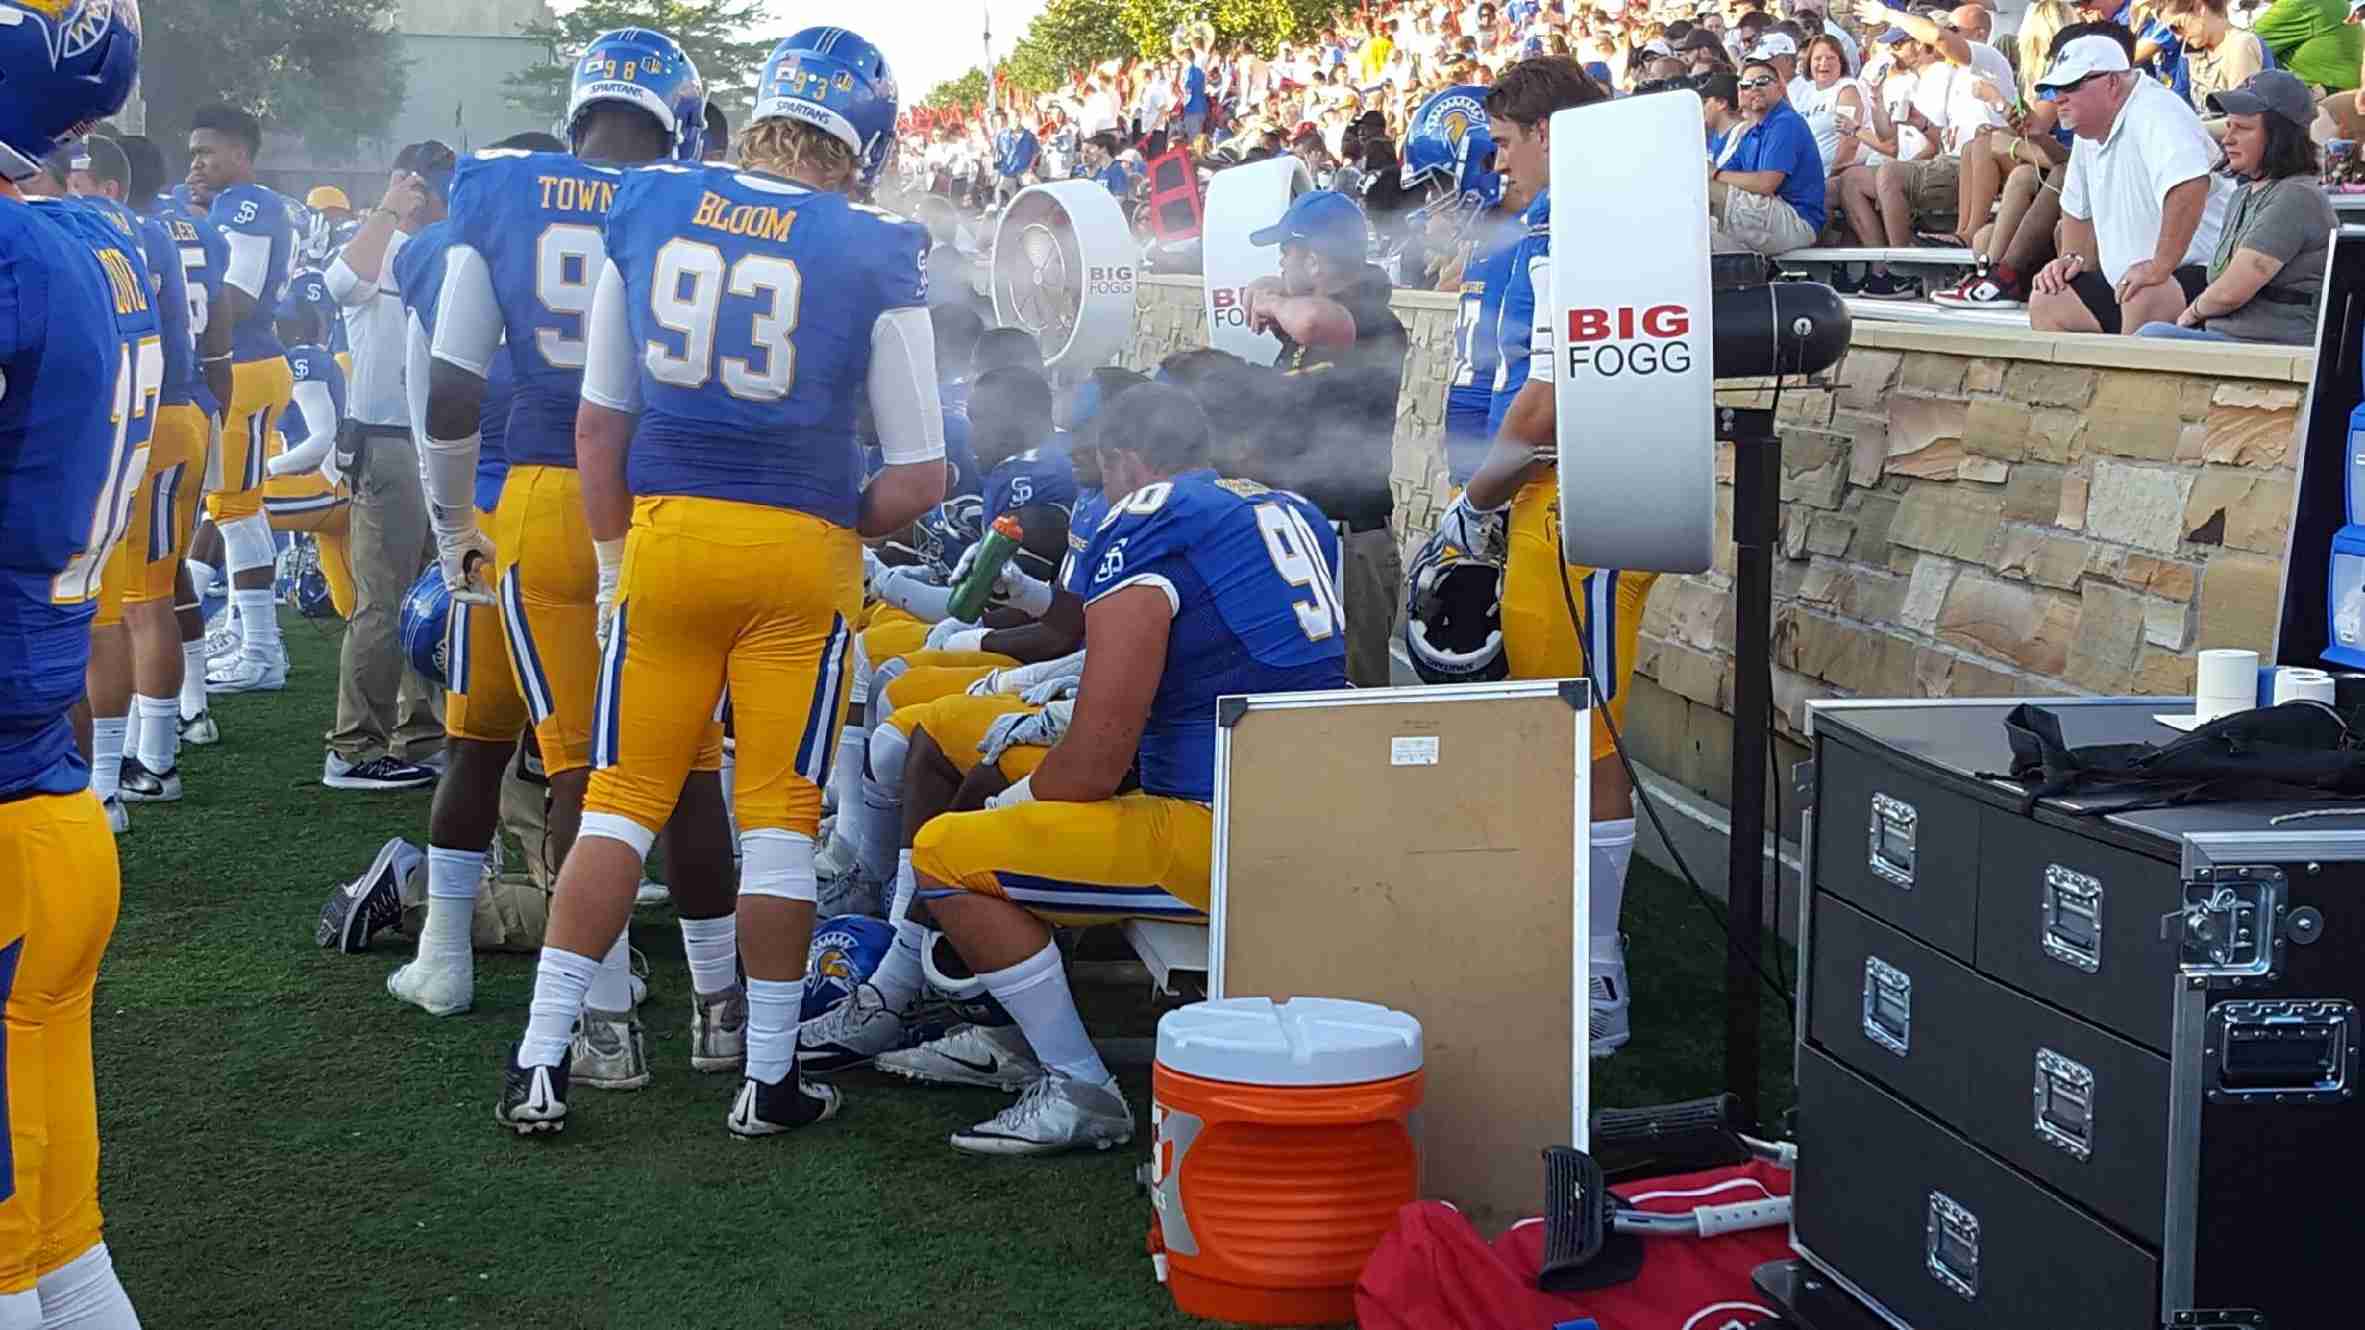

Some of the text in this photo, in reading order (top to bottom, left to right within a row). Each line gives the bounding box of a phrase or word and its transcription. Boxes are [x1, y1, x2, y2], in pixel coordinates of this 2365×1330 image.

[692, 191, 797, 243] BLOOM
[1089, 265, 1133, 282] BIG
[1089, 281, 1133, 296] FOGG
[645, 235, 802, 402] 93
[1567, 304, 1690, 343] BIG
[1568, 341, 1691, 379] FOGG
